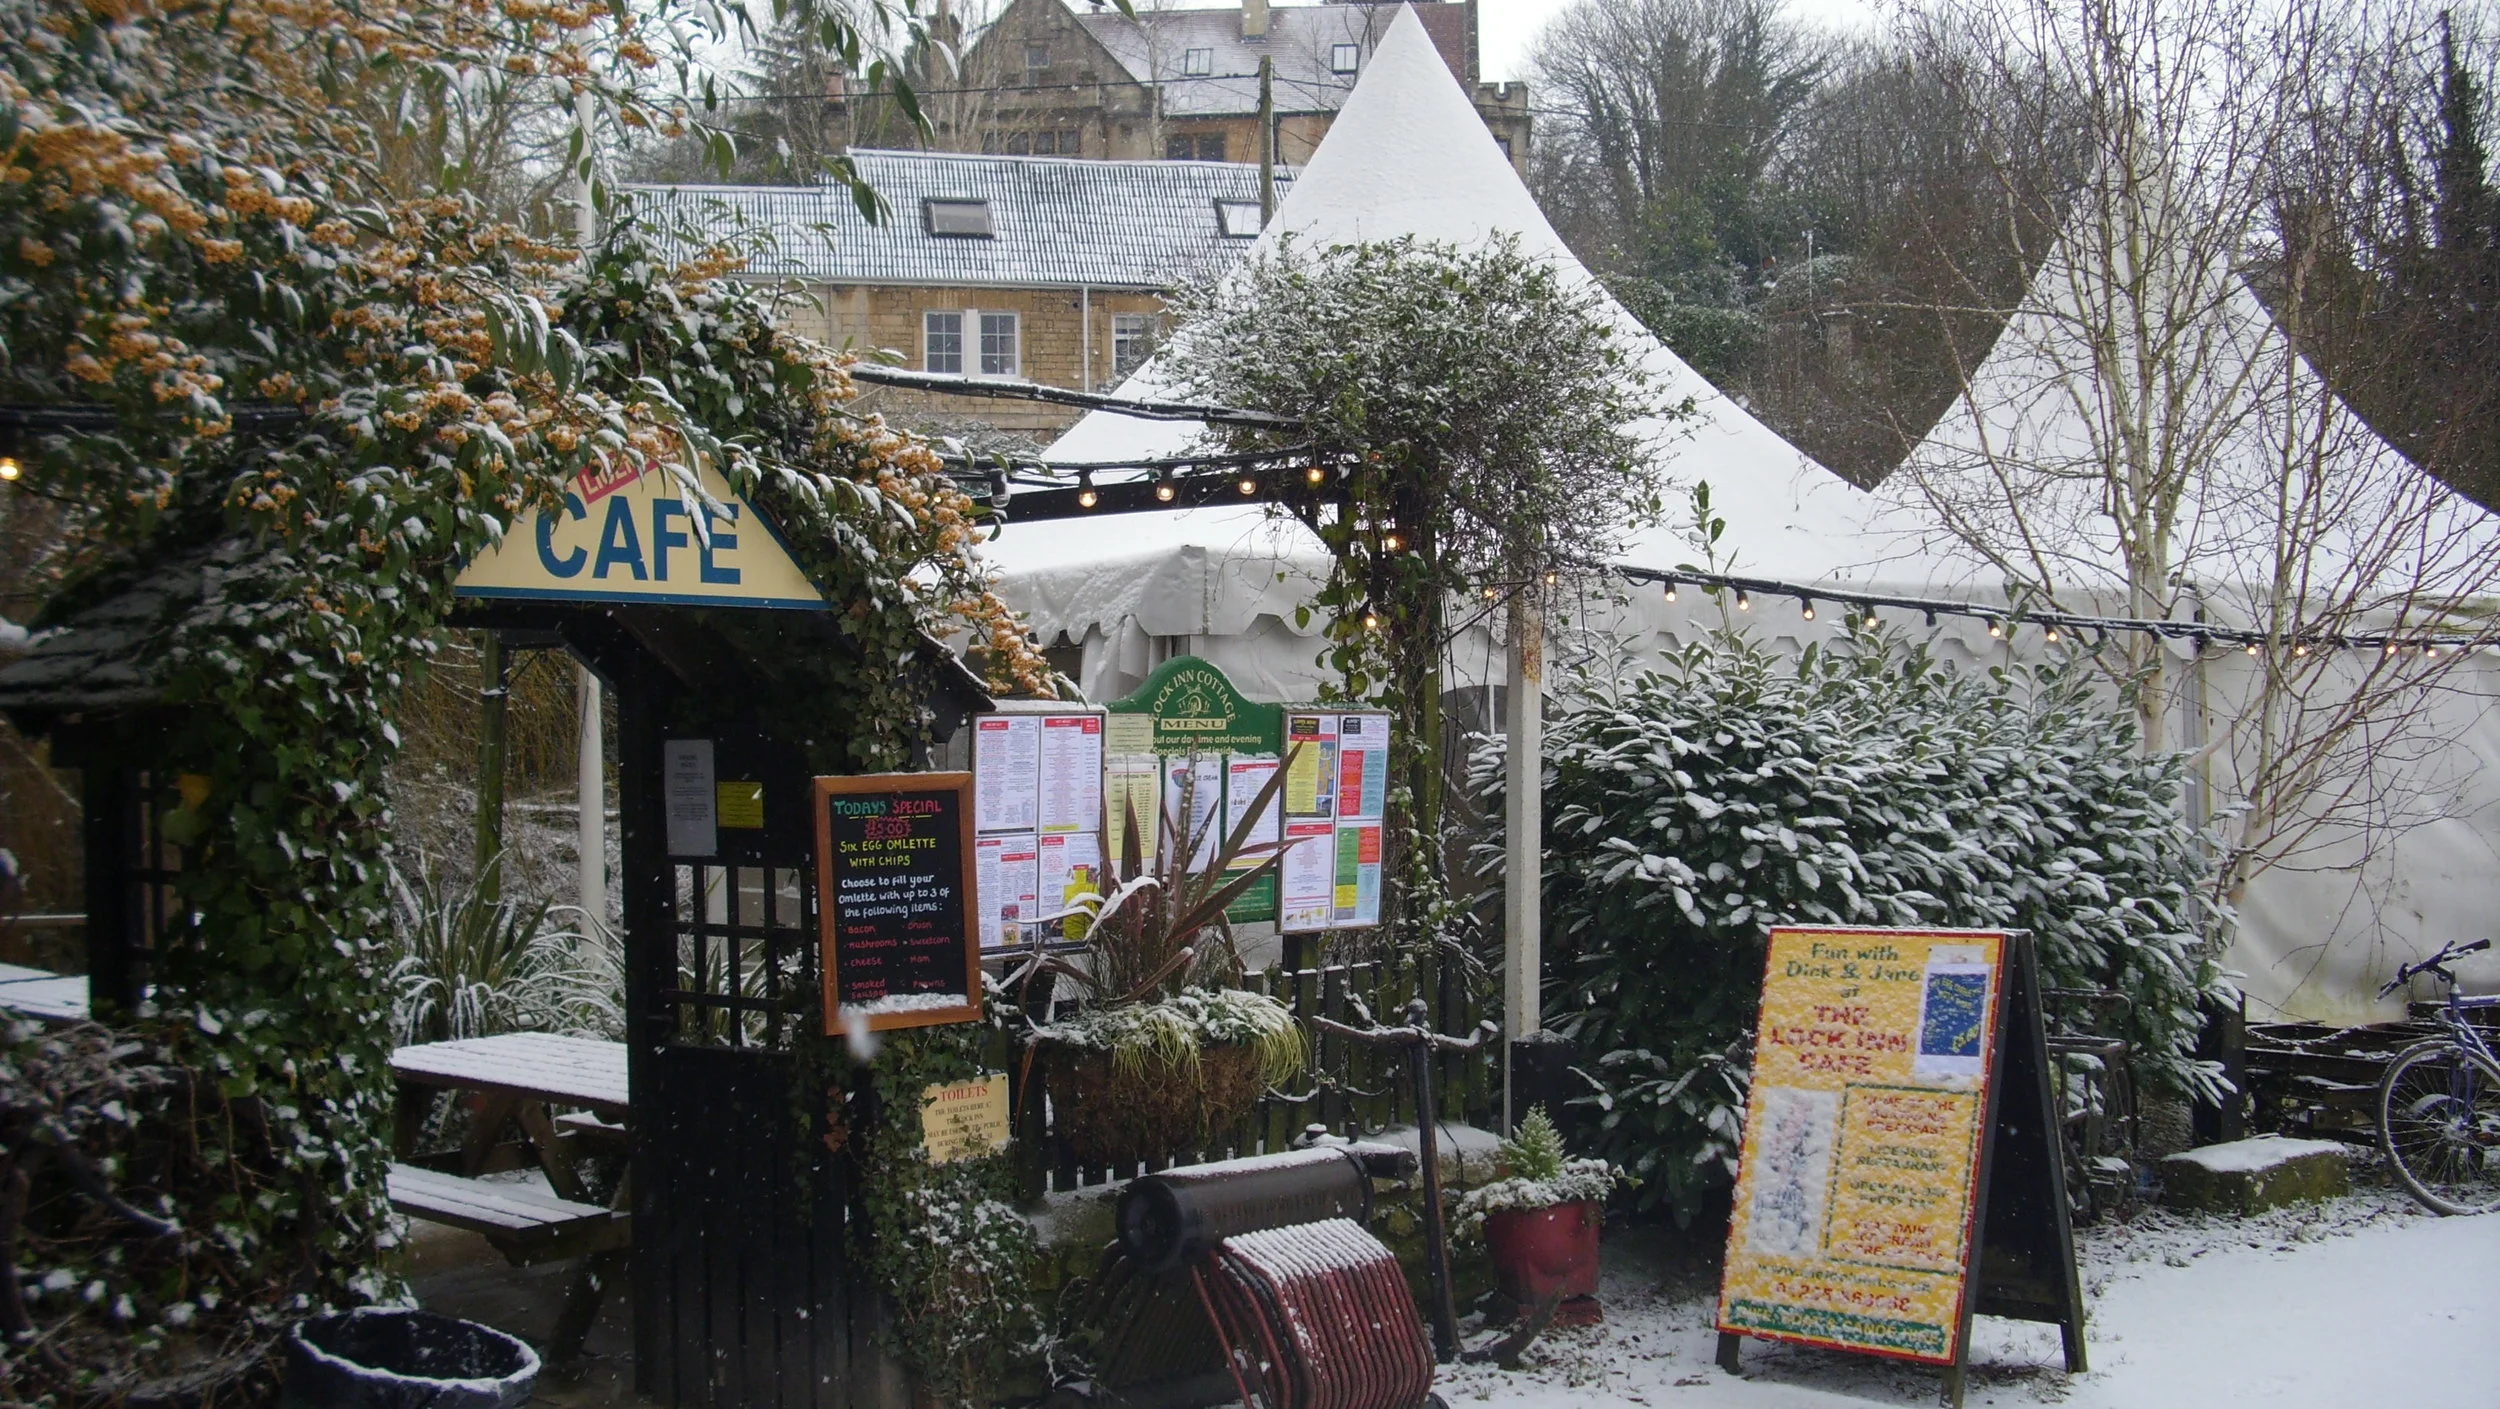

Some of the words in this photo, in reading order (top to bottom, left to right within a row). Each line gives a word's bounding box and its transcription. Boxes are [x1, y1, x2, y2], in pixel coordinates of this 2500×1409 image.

[536, 494, 741, 585] CAFE
[1173, 669, 1194, 688] INN
[1196, 670, 1236, 722] COTTAGE
[1163, 720, 1224, 729] MENU
[1166, 736, 1181, 744] our
[1181, 734, 1213, 744] dayime
[1213, 734, 1230, 744] and
[1230, 734, 1262, 745] evening
[1152, 746, 1186, 757] Specials
[1187, 746, 1212, 755] Bard
[834, 800, 886, 815] TODAYS
[892, 799, 943, 814] SPECIAL
[862, 840, 882, 852] EGG
[886, 838, 936, 850] OMLETTE
[849, 857, 876, 868] WITH
[878, 855, 911, 866] CHIPS
[841, 878, 876, 889] Choose
[879, 876, 890, 885] to
[892, 875, 907, 887] fill
[909, 874, 935, 888] your
[879, 890, 901, 901] with
[902, 889, 915, 901] up
[917, 888, 929, 898] to
[929, 888, 938, 898] 3
[845, 908, 861, 918] the
[862, 904, 909, 919] following
[847, 924, 877, 935] Bacon
[1811, 942, 1849, 960] Fun
[1857, 944, 1899, 961] with
[1786, 959, 1833, 979] Dick
[1840, 962, 1861, 979] &
[1813, 1005, 1870, 1027] THE
[1771, 1026, 1847, 1049] LOCK
[1799, 1051, 1872, 1075] CAFE
[939, 1084, 989, 1102] TOILETS
